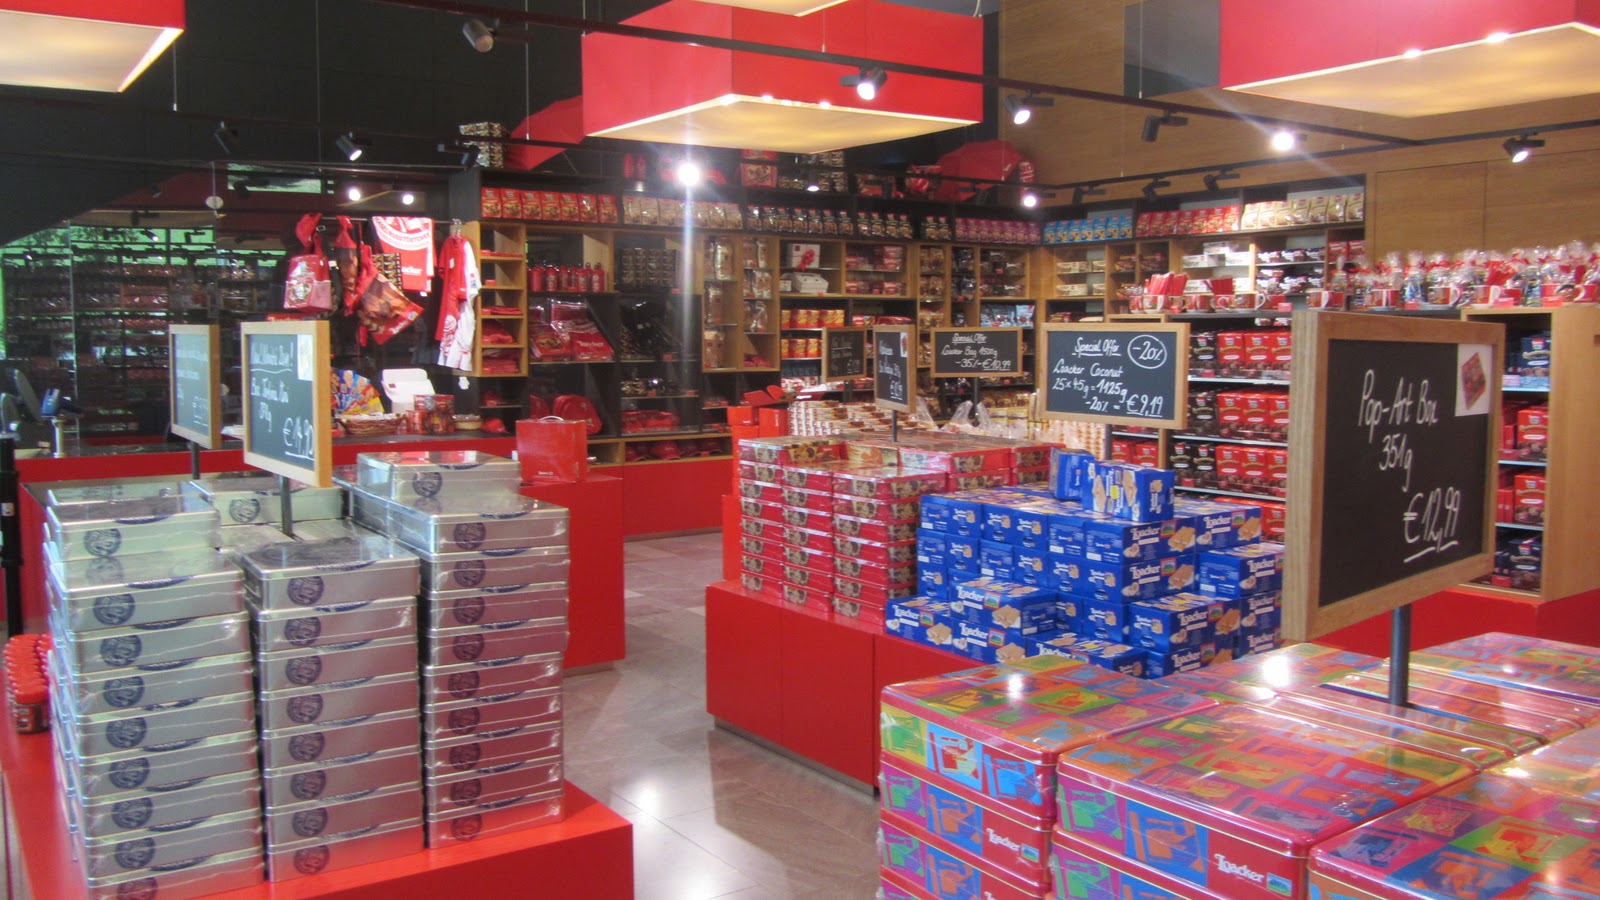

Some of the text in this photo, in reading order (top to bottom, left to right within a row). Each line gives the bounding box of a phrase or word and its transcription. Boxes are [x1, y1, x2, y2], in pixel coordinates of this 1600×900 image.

[952, 333, 974, 345] Special
[1074, 337, 1120, 358] Special Offer
[964, 346, 977, 358] Bag
[1053, 358, 1124, 377] Loacker Coconut
[1126, 395, 1164, 416] €9,19
[1416, 379, 1439, 426] Box
[1203, 516, 1231, 529] Loacker
[1403, 486, 1461, 553] €12,99
[1130, 526, 1160, 541] Loacker
[1130, 565, 1161, 580] Loacker
[1247, 558, 1275, 573] Loacker
[955, 585, 985, 602] Loacker
[892, 604, 920, 620] Loacker
[1177, 609, 1208, 626] Loacker
[959, 622, 988, 639] Loacker
[1247, 633, 1274, 648] Loacker
[1171, 650, 1201, 668] Loacker
[986, 828, 1021, 852] Loacker
[1214, 853, 1264, 884] Loacker
